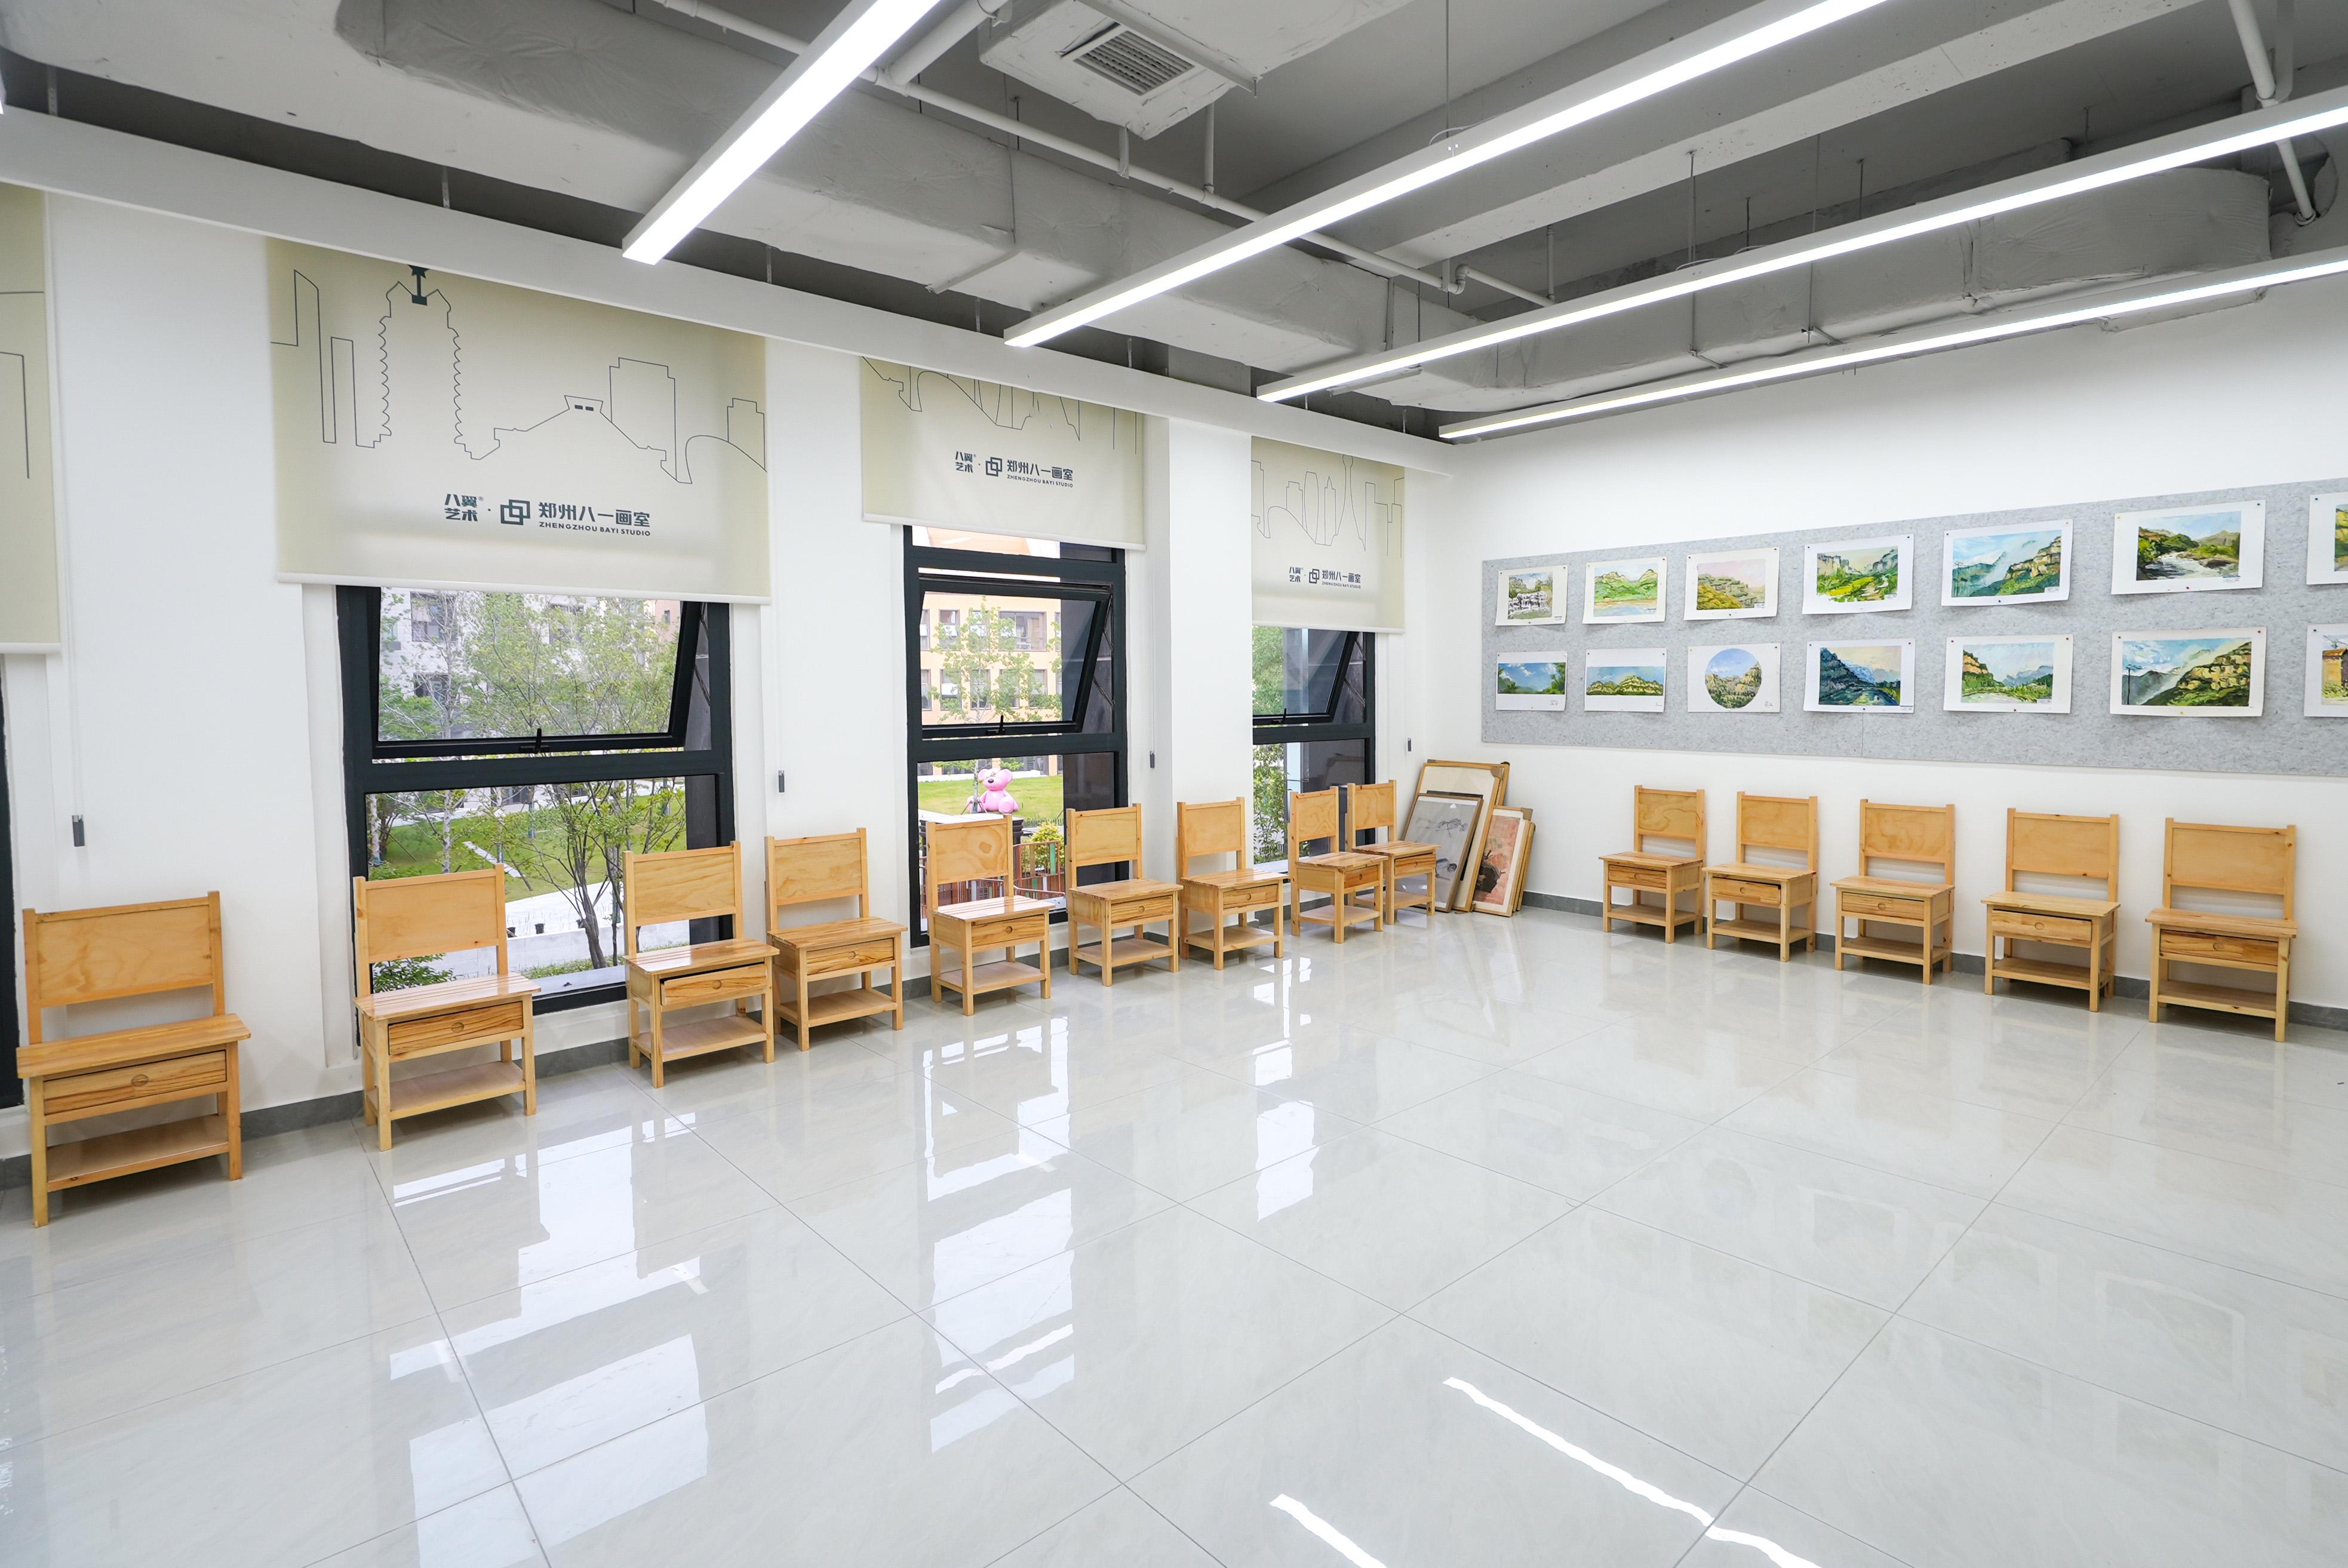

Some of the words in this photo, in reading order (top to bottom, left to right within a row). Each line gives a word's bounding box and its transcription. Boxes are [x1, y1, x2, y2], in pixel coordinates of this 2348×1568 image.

[955, 462, 973, 473] 艺术
[1007, 459, 1073, 481] 郑州八一画室
[1007, 475, 1041, 484] ZHENGZHOU
[444, 508, 478, 521] 艺术
[539, 502, 650, 527] 郑州八一画室
[539, 521, 597, 531] ZHENGZHOU
